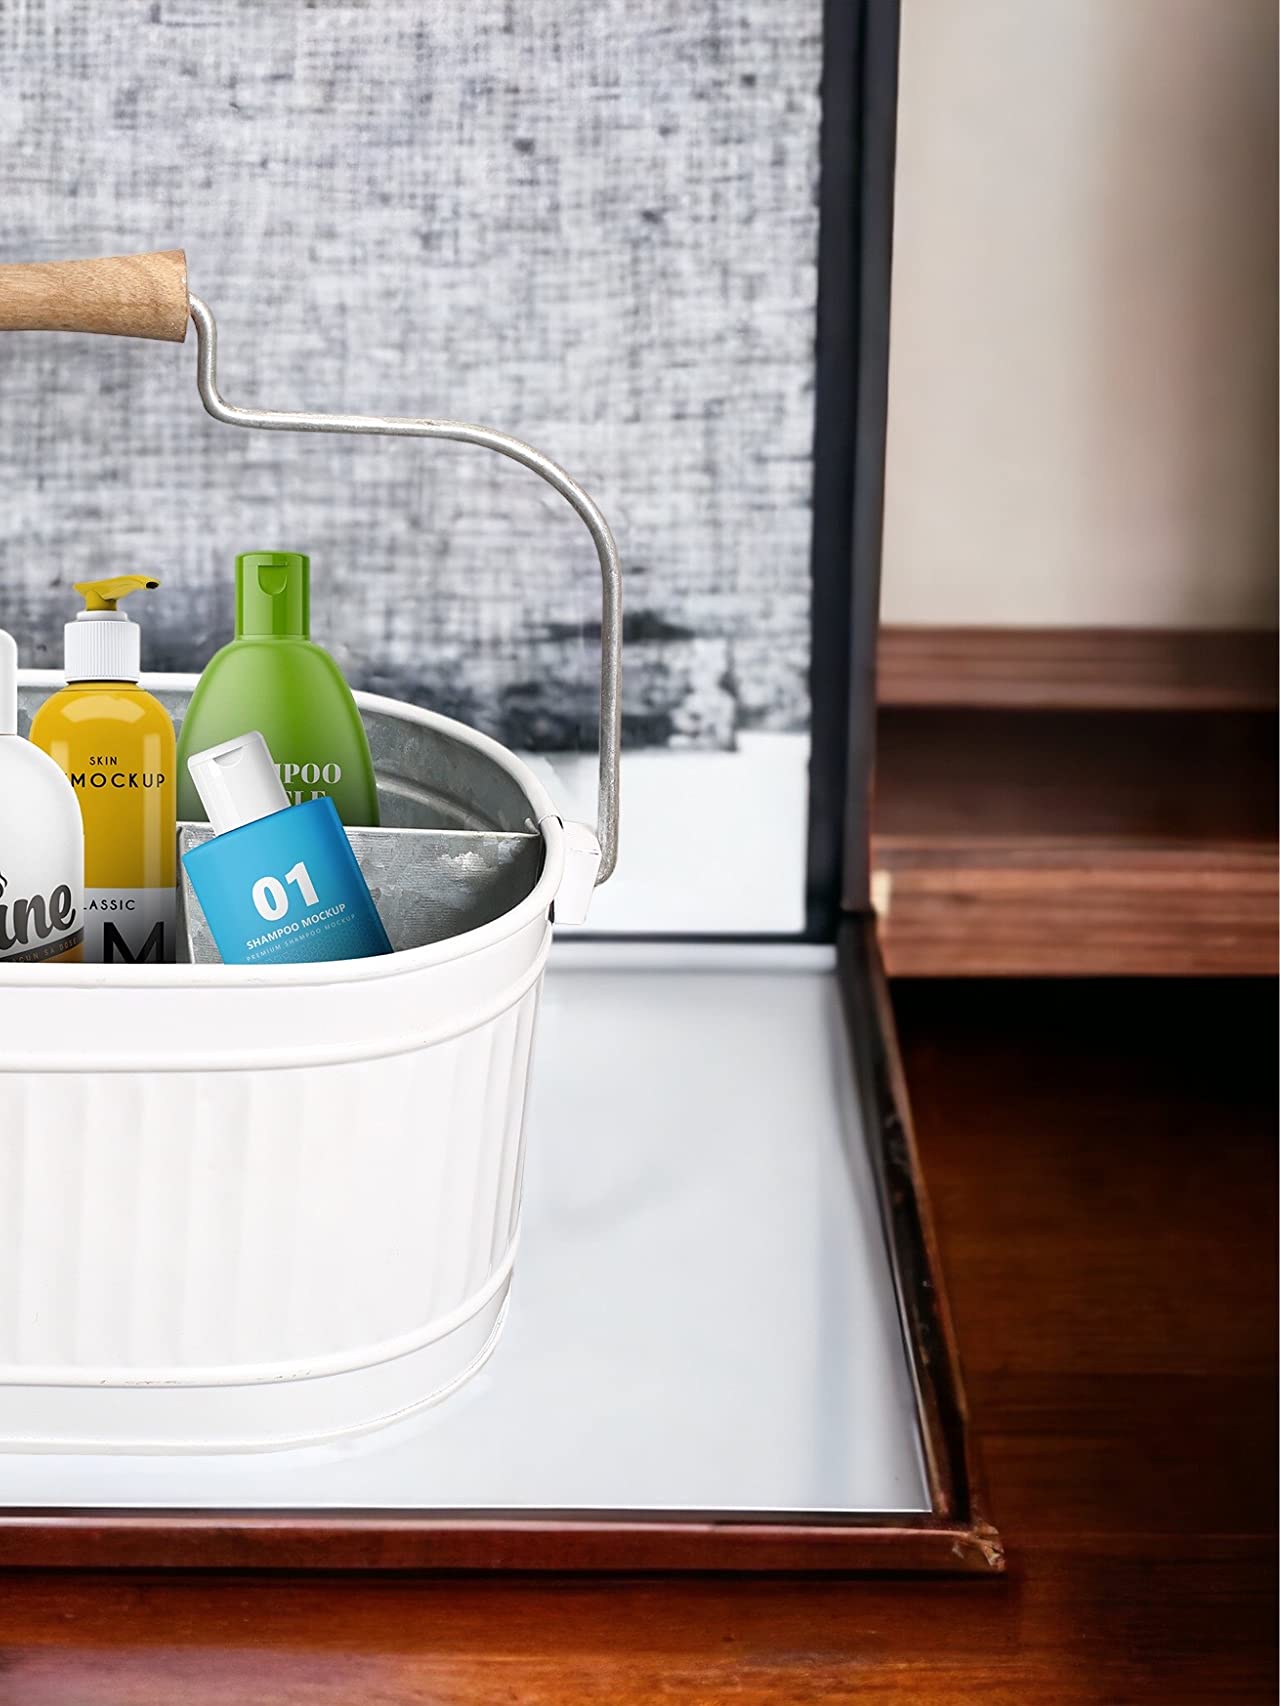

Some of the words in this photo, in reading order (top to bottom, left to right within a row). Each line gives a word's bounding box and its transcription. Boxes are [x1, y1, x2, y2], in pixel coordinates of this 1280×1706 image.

[89, 756, 117, 766] SKIN
[71, 772, 165, 788] MOCKUP
[274, 763, 342, 784] POO
[251, 861, 320, 921] 01
[83, 899, 136, 911] ASSIC
[246, 922, 300, 950] SHAMPOO
[301, 903, 346, 928] MOCKUP
